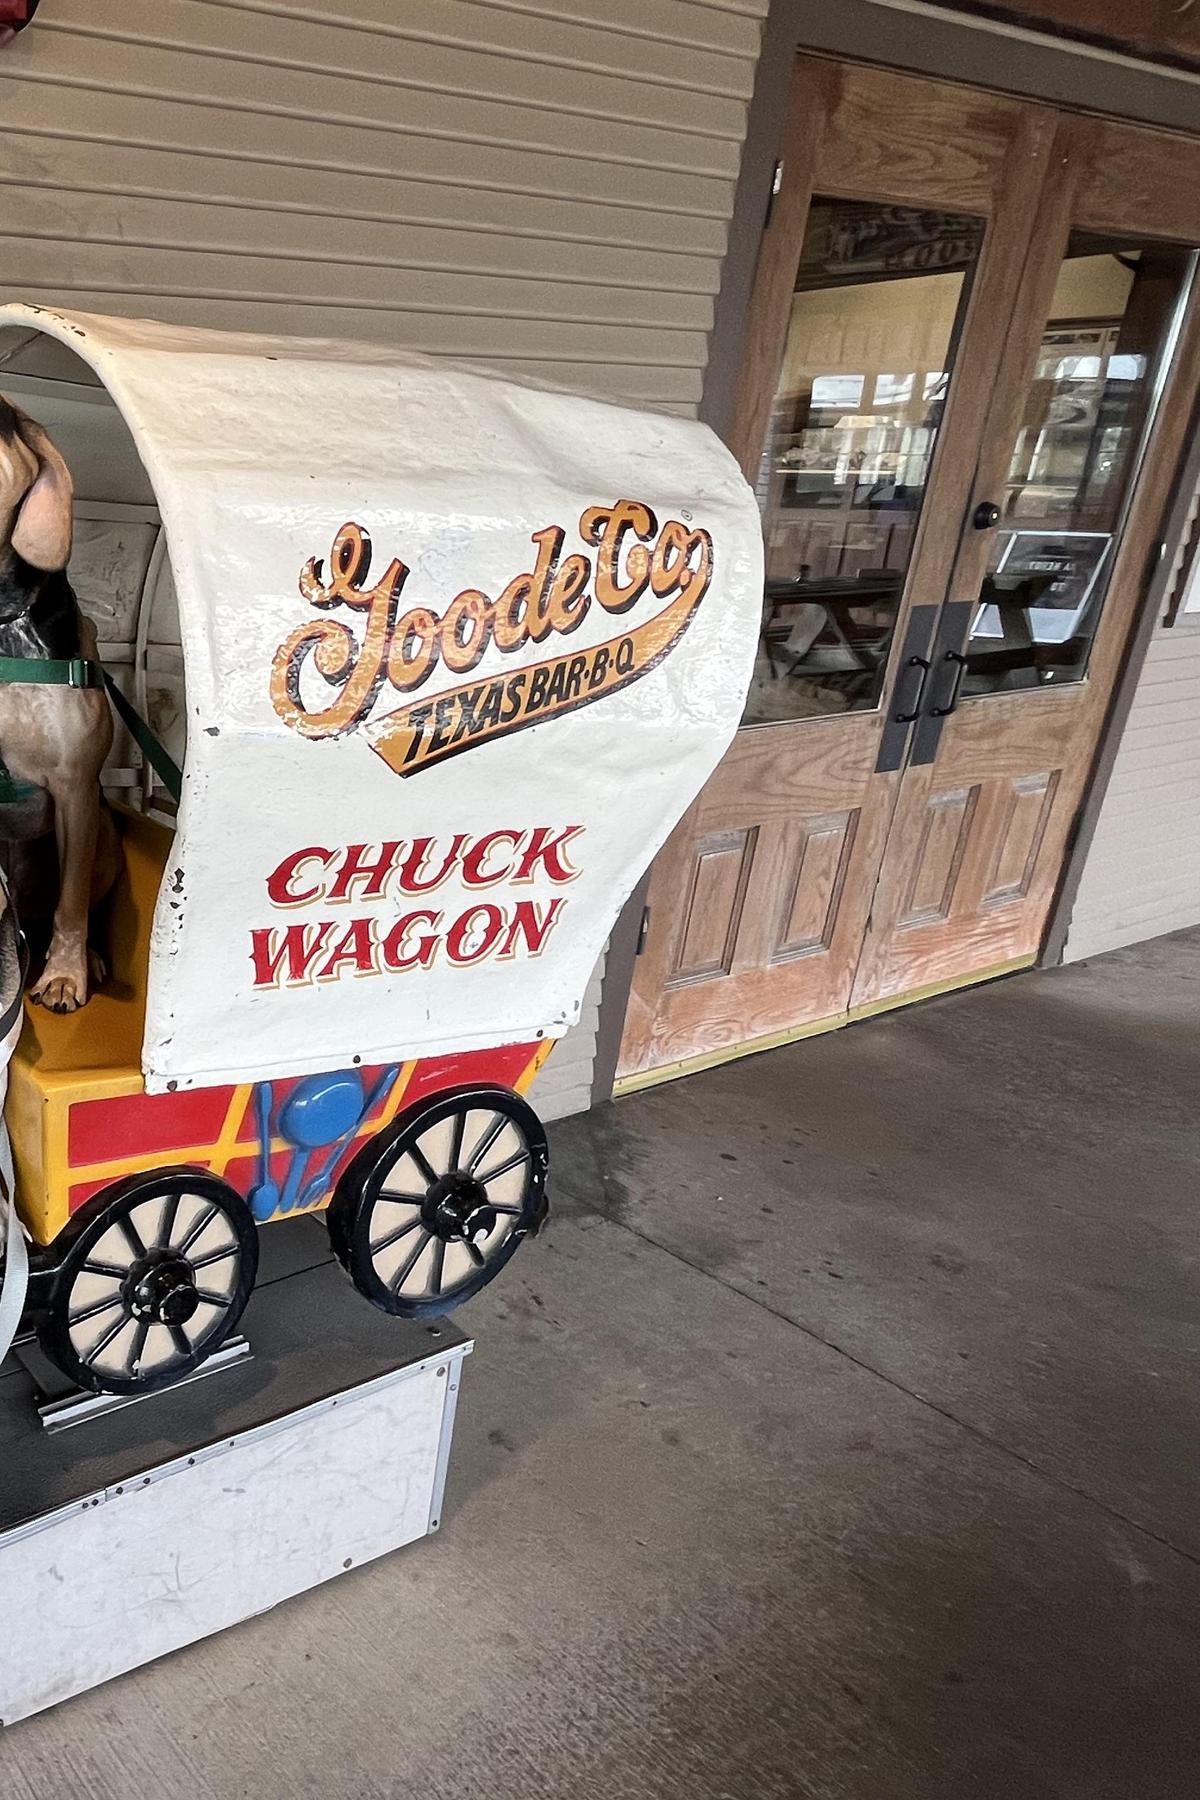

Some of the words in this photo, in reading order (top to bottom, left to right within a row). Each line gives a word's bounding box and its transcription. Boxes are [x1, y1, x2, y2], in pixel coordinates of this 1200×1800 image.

[269, 521, 592, 741] Goode
[403, 674, 526, 765] TEXAS
[266, 825, 585, 909] CHUCK
[249, 898, 568, 990] WAGON
